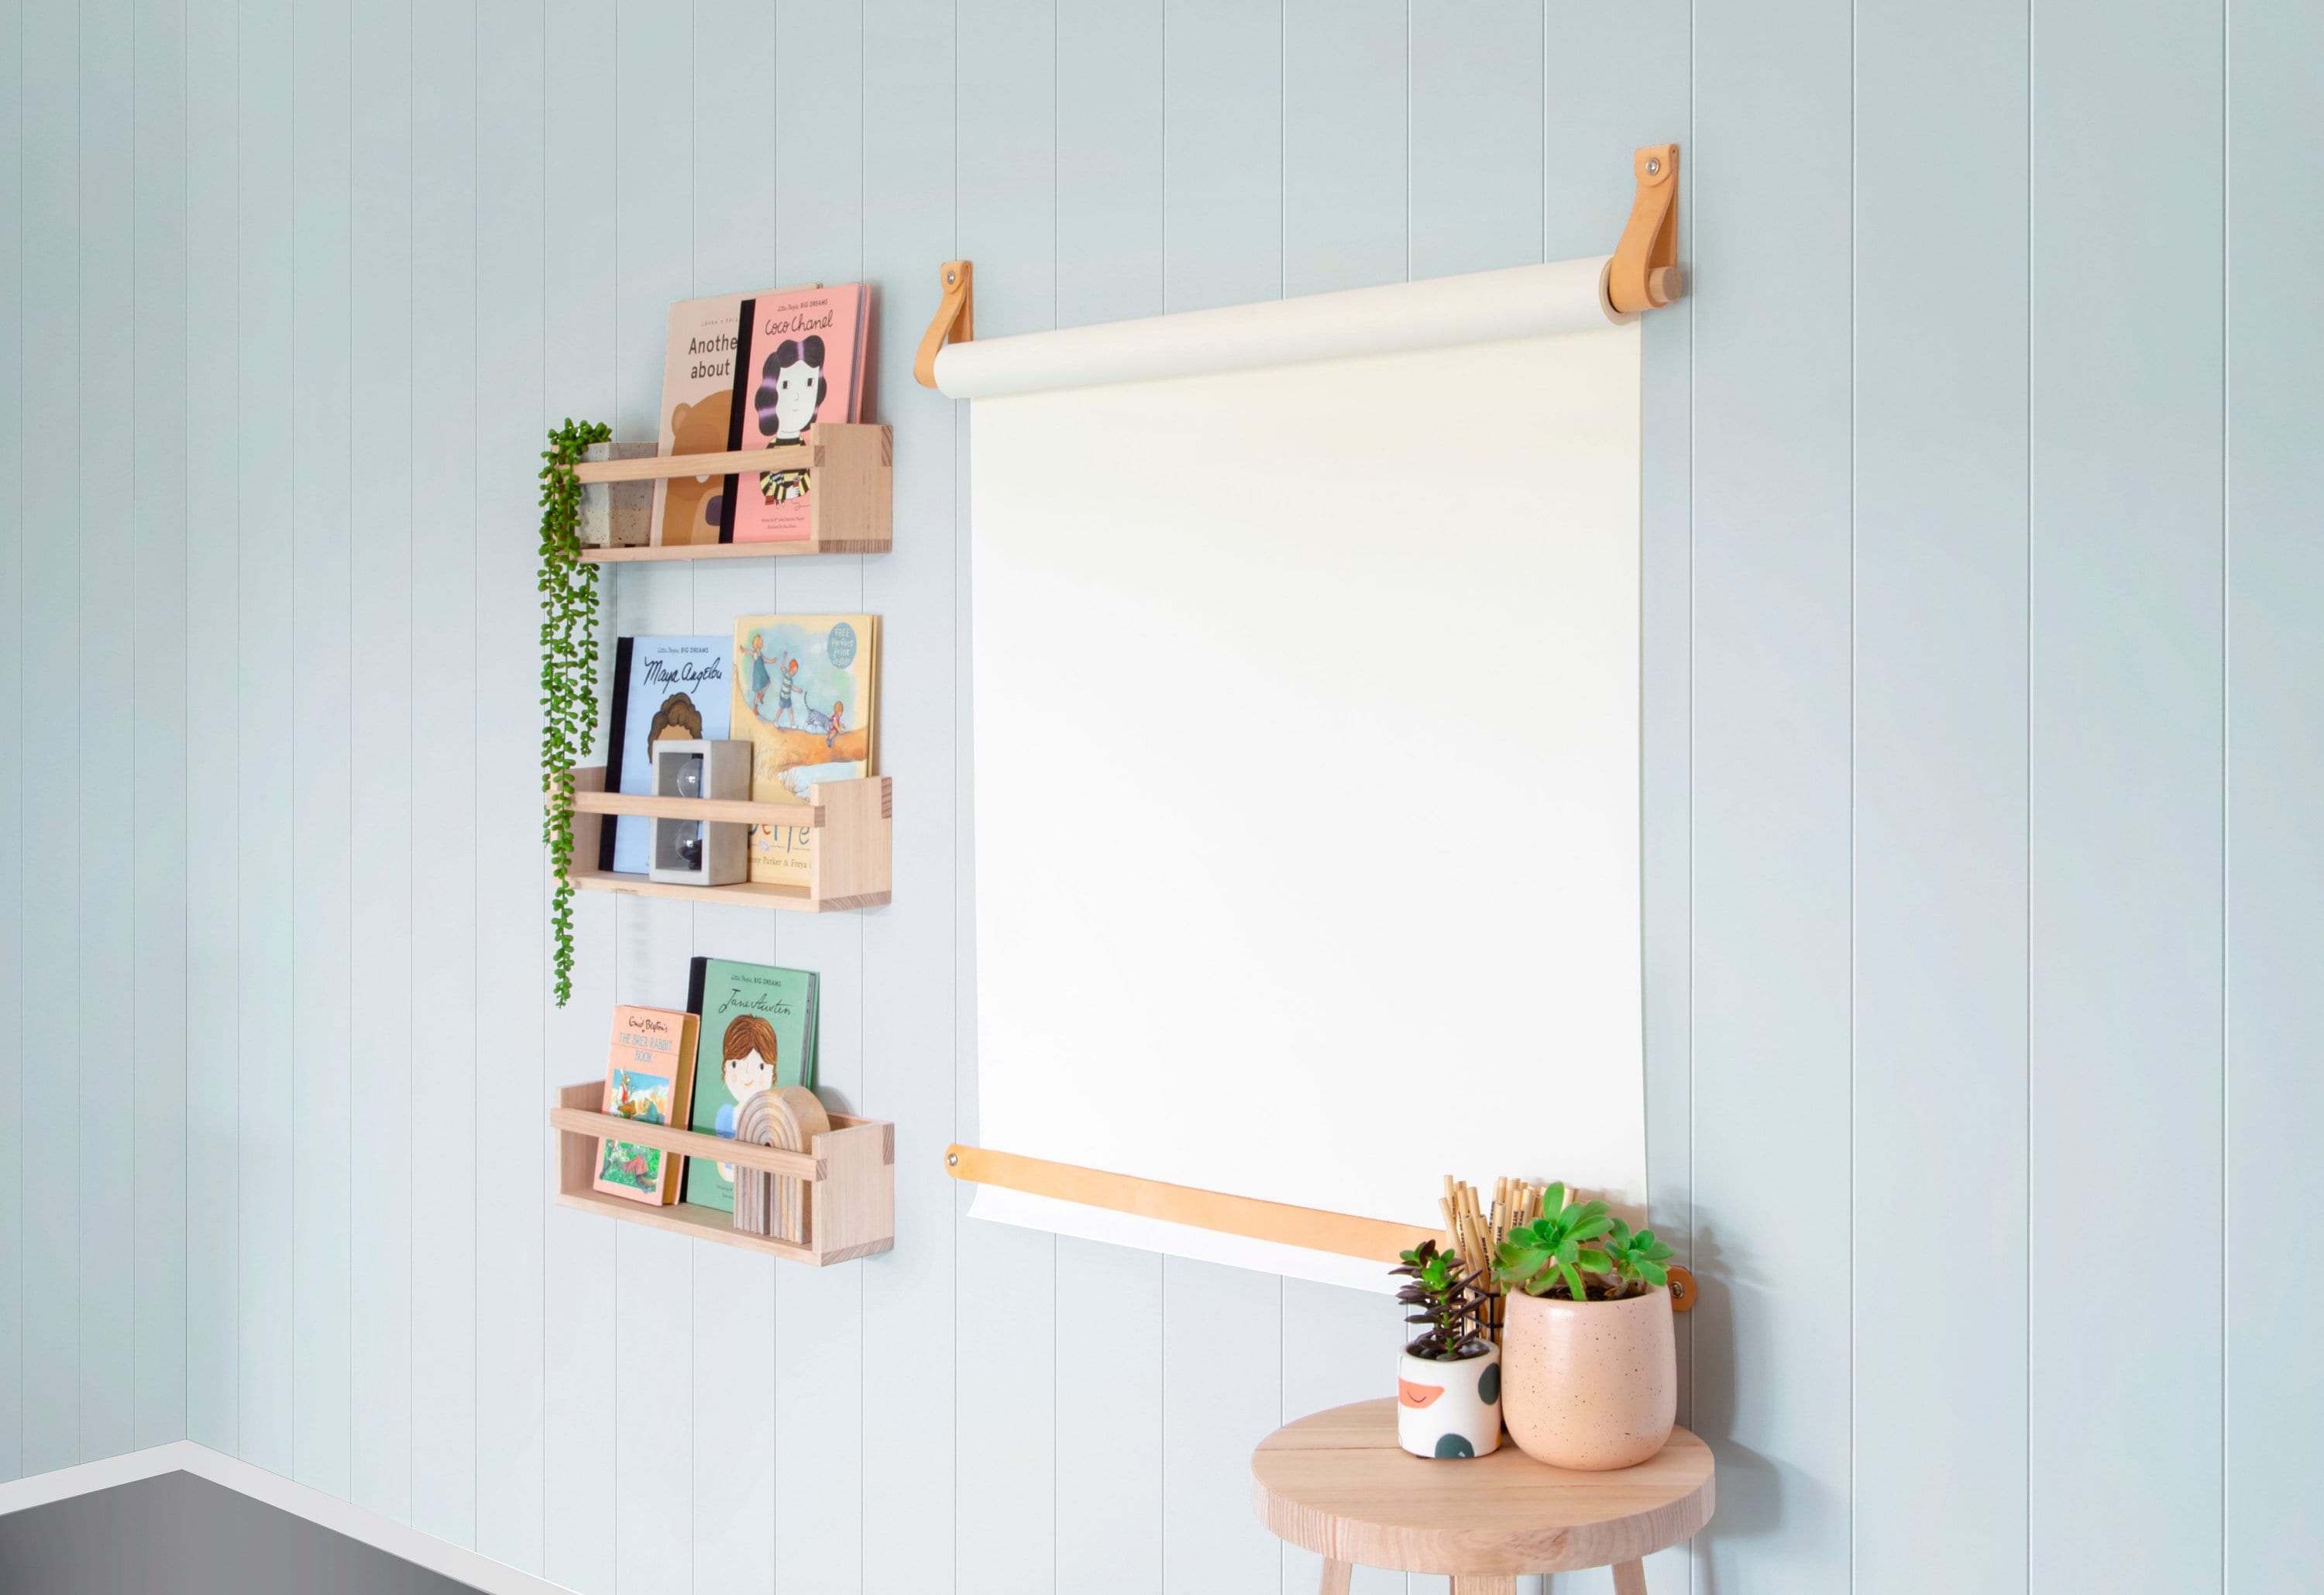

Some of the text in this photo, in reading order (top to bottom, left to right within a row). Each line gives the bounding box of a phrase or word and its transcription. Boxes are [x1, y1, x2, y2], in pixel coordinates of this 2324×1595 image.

[810, 299, 827, 308] DREAMS
[765, 309, 834, 335] Coco Chanel
[688, 333, 737, 355] Anothe
[690, 358, 731, 379] about
[835, 628, 850, 637] FREE
[644, 656, 723, 694] Maya Angelou
[763, 856, 782, 865] Parker
[763, 978, 782, 987] DREAMS
[719, 988, 793, 1015] Jane Austen
[629, 1016, 645, 1027] Enid
[620, 1033, 631, 1044] THE
[650, 1037, 673, 1051] RABBIT
[634, 1050, 653, 1063] BOOK
